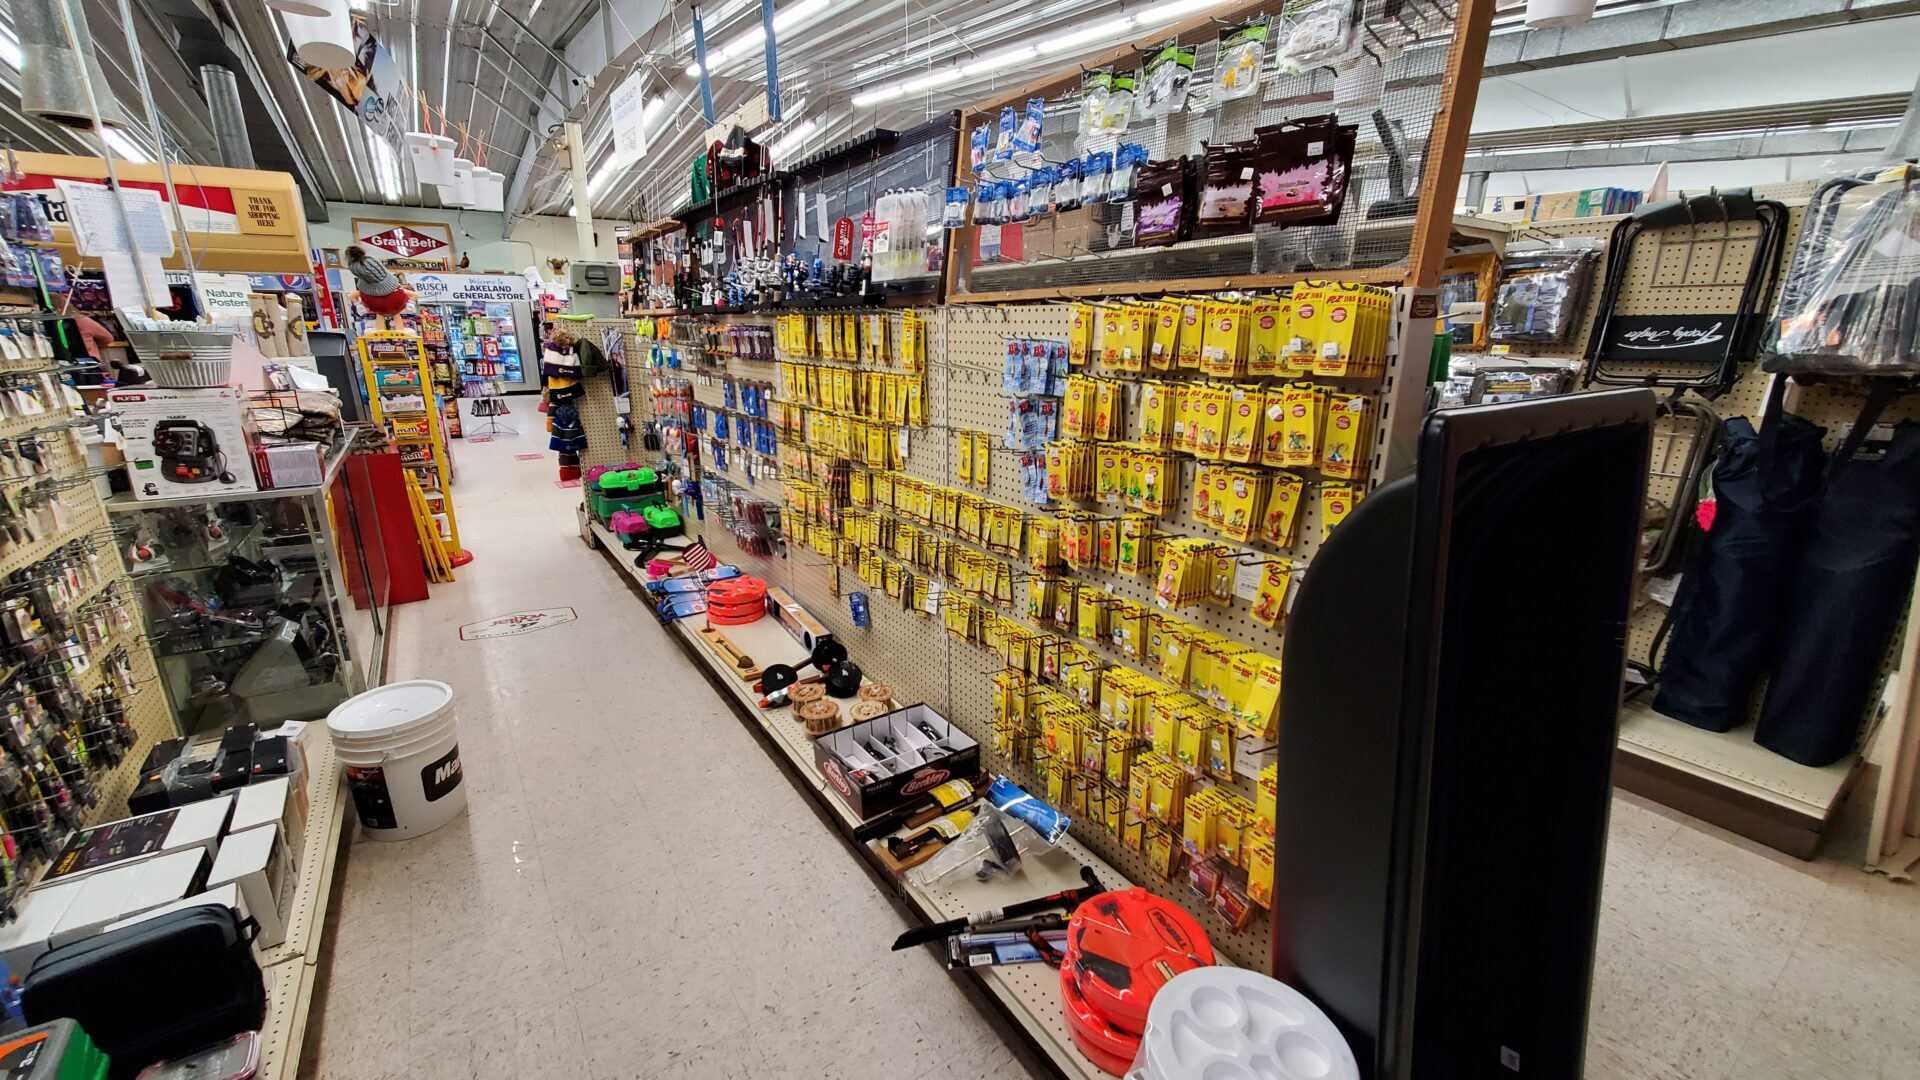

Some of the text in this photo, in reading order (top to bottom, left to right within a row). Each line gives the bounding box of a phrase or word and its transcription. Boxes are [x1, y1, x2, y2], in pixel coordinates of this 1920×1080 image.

[248, 196, 273, 205] THANK
[248, 204, 260, 212] YOU
[248, 211, 280, 220] SHOPPING
[256, 219, 276, 228] HERE
[371, 234, 437, 249] Grain Belt
[468, 277, 497, 285] Welcome
[416, 283, 448, 292] BUSCH
[464, 284, 512, 293] LAKELAND
[205, 289, 243, 299] Nature
[452, 292, 525, 301] GENERAL STORE
[208, 298, 249, 307] Posters
[1624, 321, 1724, 344] Trophy Angler
[827, 763, 850, 794] Berkley
[906, 770, 946, 793] Berkley
